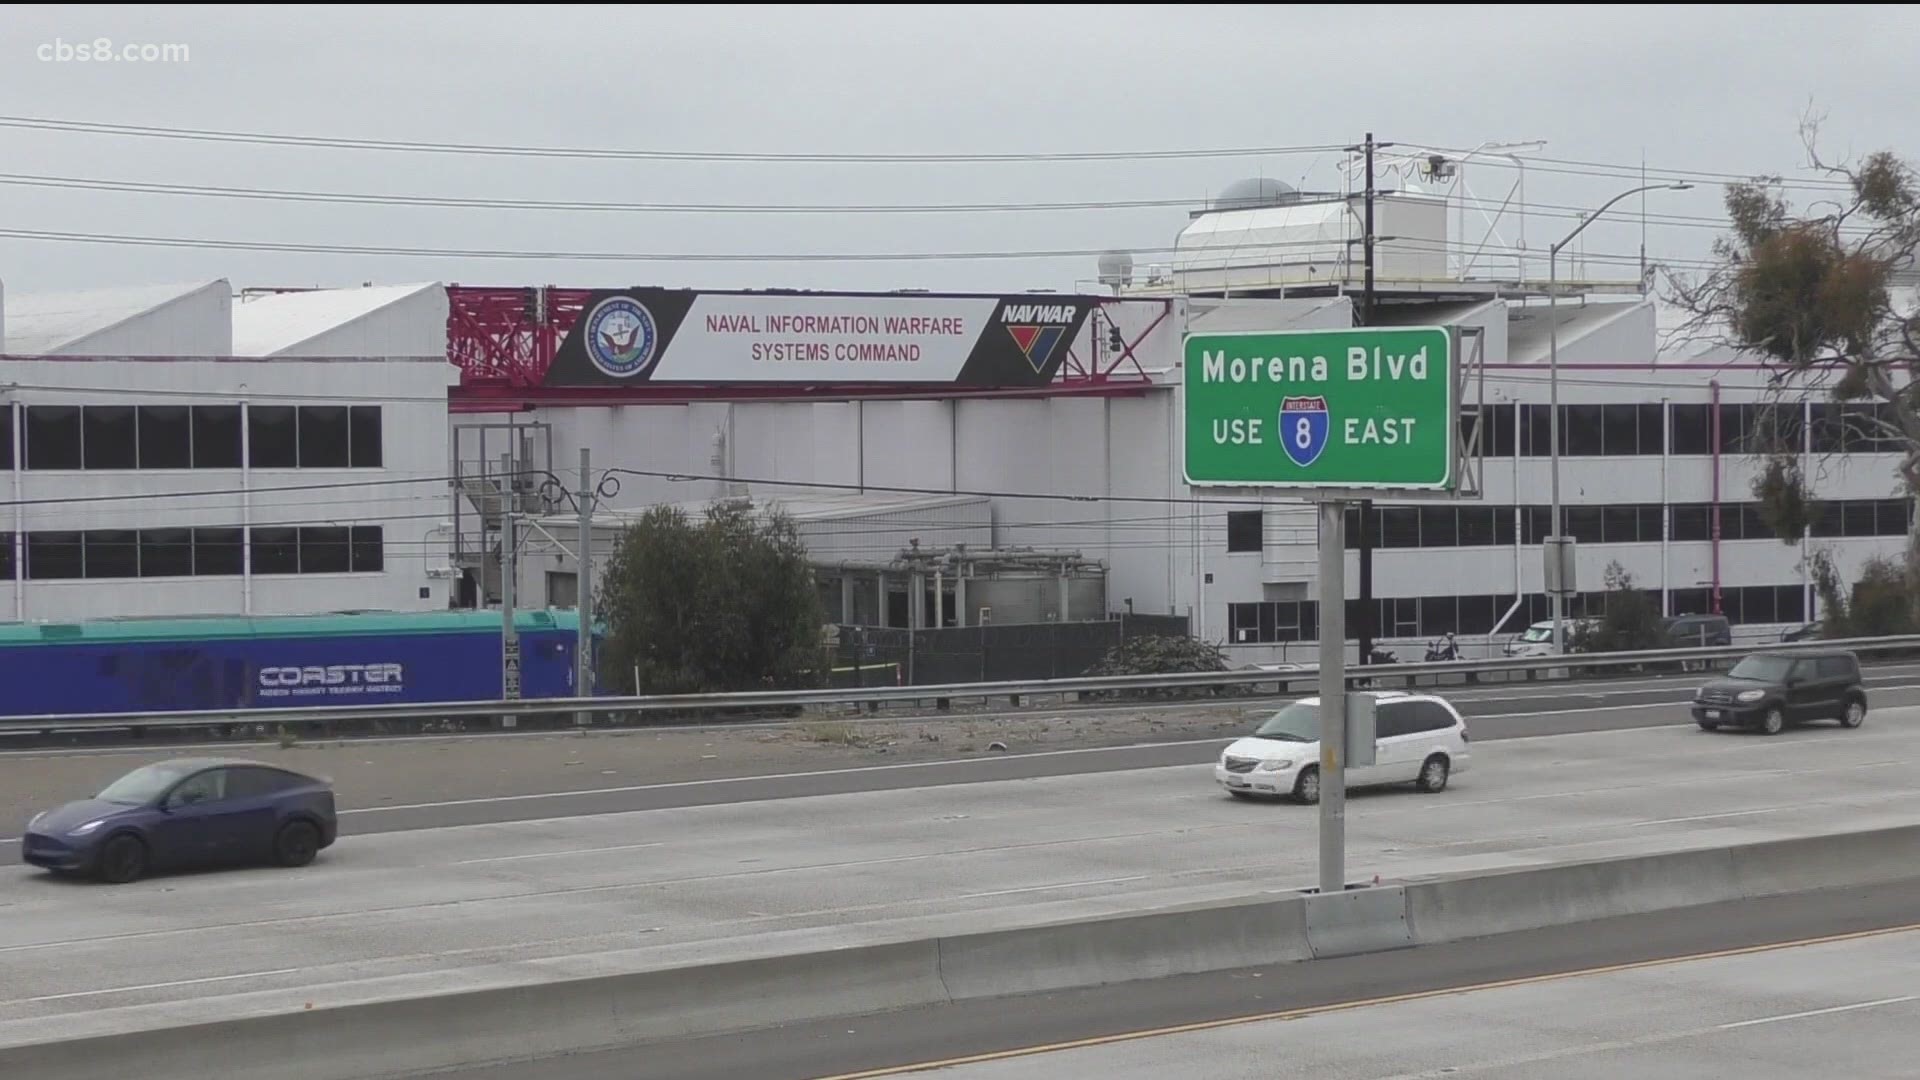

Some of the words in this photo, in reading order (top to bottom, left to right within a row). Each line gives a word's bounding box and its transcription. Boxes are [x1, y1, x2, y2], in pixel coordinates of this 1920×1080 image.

[1000, 304, 1077, 323] NAVWAR
[706, 314, 760, 333] NAVAL
[765, 315, 879, 334] INFORMATION
[884, 317, 963, 335] WARFARE
[751, 343, 830, 361] SYSTEMS
[835, 344, 921, 362] COMMAND
[1202, 350, 1329, 383] Morena
[1347, 345, 1428, 381] Blvd
[1285, 400, 1321, 410] INTERSTATE
[1213, 418, 1263, 444] USE
[1296, 417, 1311, 449] 8
[1344, 418, 1416, 444] EAST
[260, 662, 402, 686] COASTER
